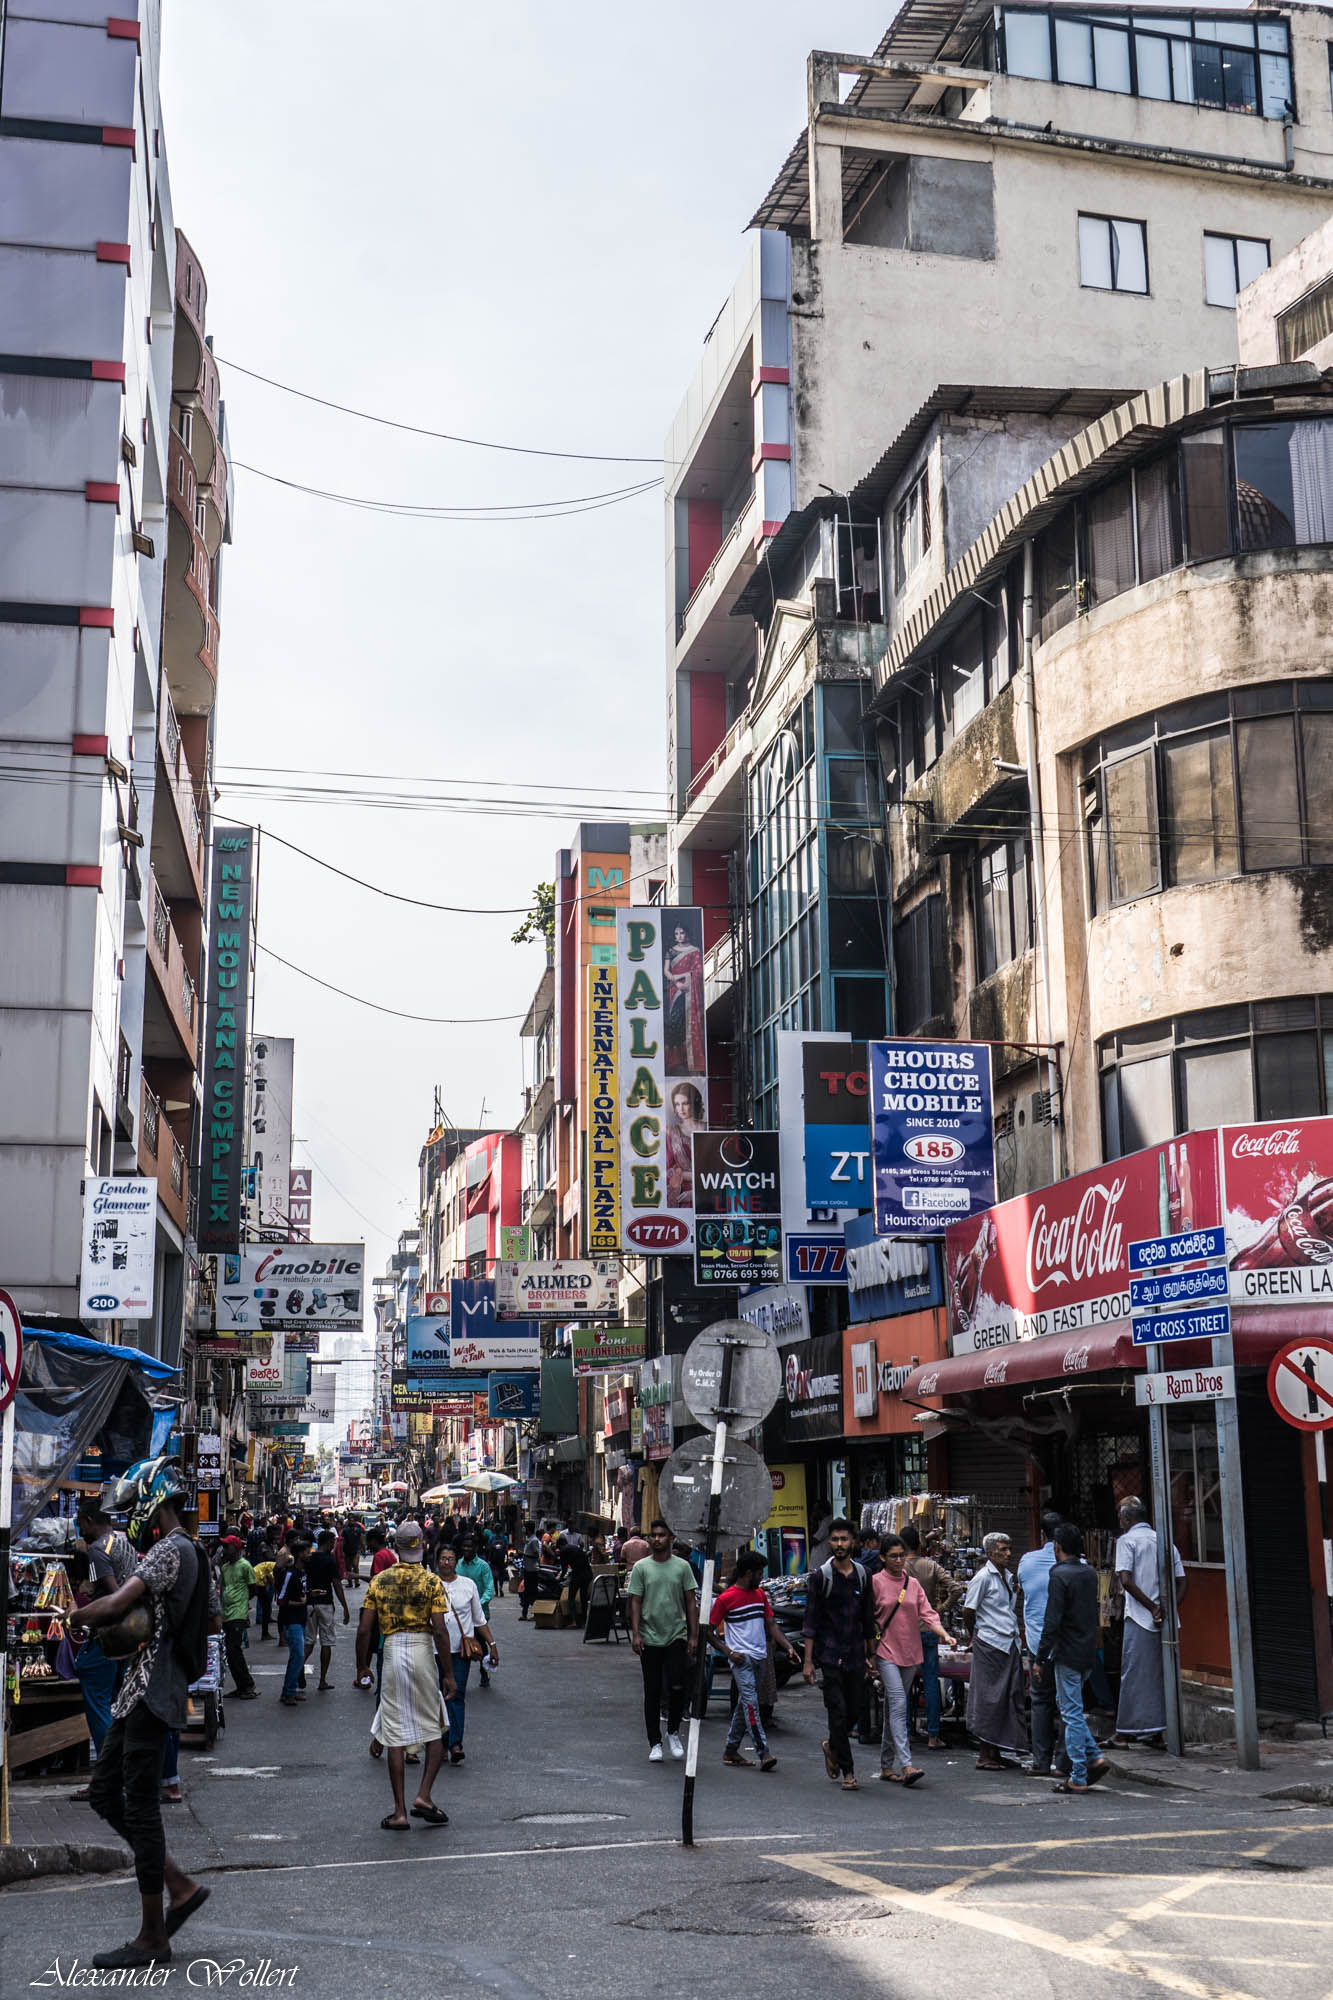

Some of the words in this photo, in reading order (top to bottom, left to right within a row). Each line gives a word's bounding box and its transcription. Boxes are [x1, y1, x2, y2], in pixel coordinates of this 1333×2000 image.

[217, 864, 244, 920] NEW
[214, 932, 241, 1070] MOULANA
[593, 968, 615, 1154] INTERNATIONAL
[626, 920, 664, 1209] PALACE
[888, 1050, 975, 1070] HOURS
[820, 1071, 868, 1096] TC
[884, 1072, 980, 1091] CHOICE
[883, 1093, 982, 1113] MOBILE
[906, 1117, 934, 1128] SINCE
[937, 1118, 961, 1129] 2010
[209, 1081, 234, 1223] COMPLEX
[915, 1142, 954, 1158] 185
[1232, 1128, 1303, 1159] Coca-Cola
[830, 1151, 870, 1182] ZT
[99, 1182, 148, 1196] London
[700, 1172, 775, 1190] WATCH
[93, 1197, 151, 1215] Glamour
[593, 1160, 616, 1233] PLAZA
[715, 1195, 762, 1212] LINE
[922, 1198, 968, 1208] Facebook
[885, 1213, 973, 1228] Hourschoicem
[592, 1236, 615, 1246] 169
[632, 1225, 681, 1241] 177/1
[1026, 1176, 1128, 1293] Coca-Cola
[1138, 1243, 1167, 1266] දෙවන
[311, 1276, 322, 1284] for
[323, 1275, 333, 1283] all
[521, 1274, 592, 1289] AHMED
[714, 1270, 738, 1279] 0766
[740, 1270, 758, 1278] 695
[761, 1269, 779, 1278] 996
[1245, 1270, 1302, 1296] GREEN
[1310, 1268, 1333, 1293] LA
[527, 1290, 587, 1299] BROTHERS
[1132, 1284, 1139, 1300] 2
[92, 1298, 115, 1308] 200
[974, 1324, 1010, 1350] GREEN
[1015, 1314, 1048, 1340] LAND
[1053, 1304, 1085, 1332] FAST
[1091, 1294, 1131, 1323] FOOD
[1135, 1320, 1151, 1341] 2nd
[1154, 1320, 1186, 1338] CROSS
[1188, 1313, 1226, 1334] STREET
[412, 1350, 450, 1359] MOBIL
[1166, 1375, 1193, 1400] Ram
[1195, 1372, 1223, 1393] Bros
